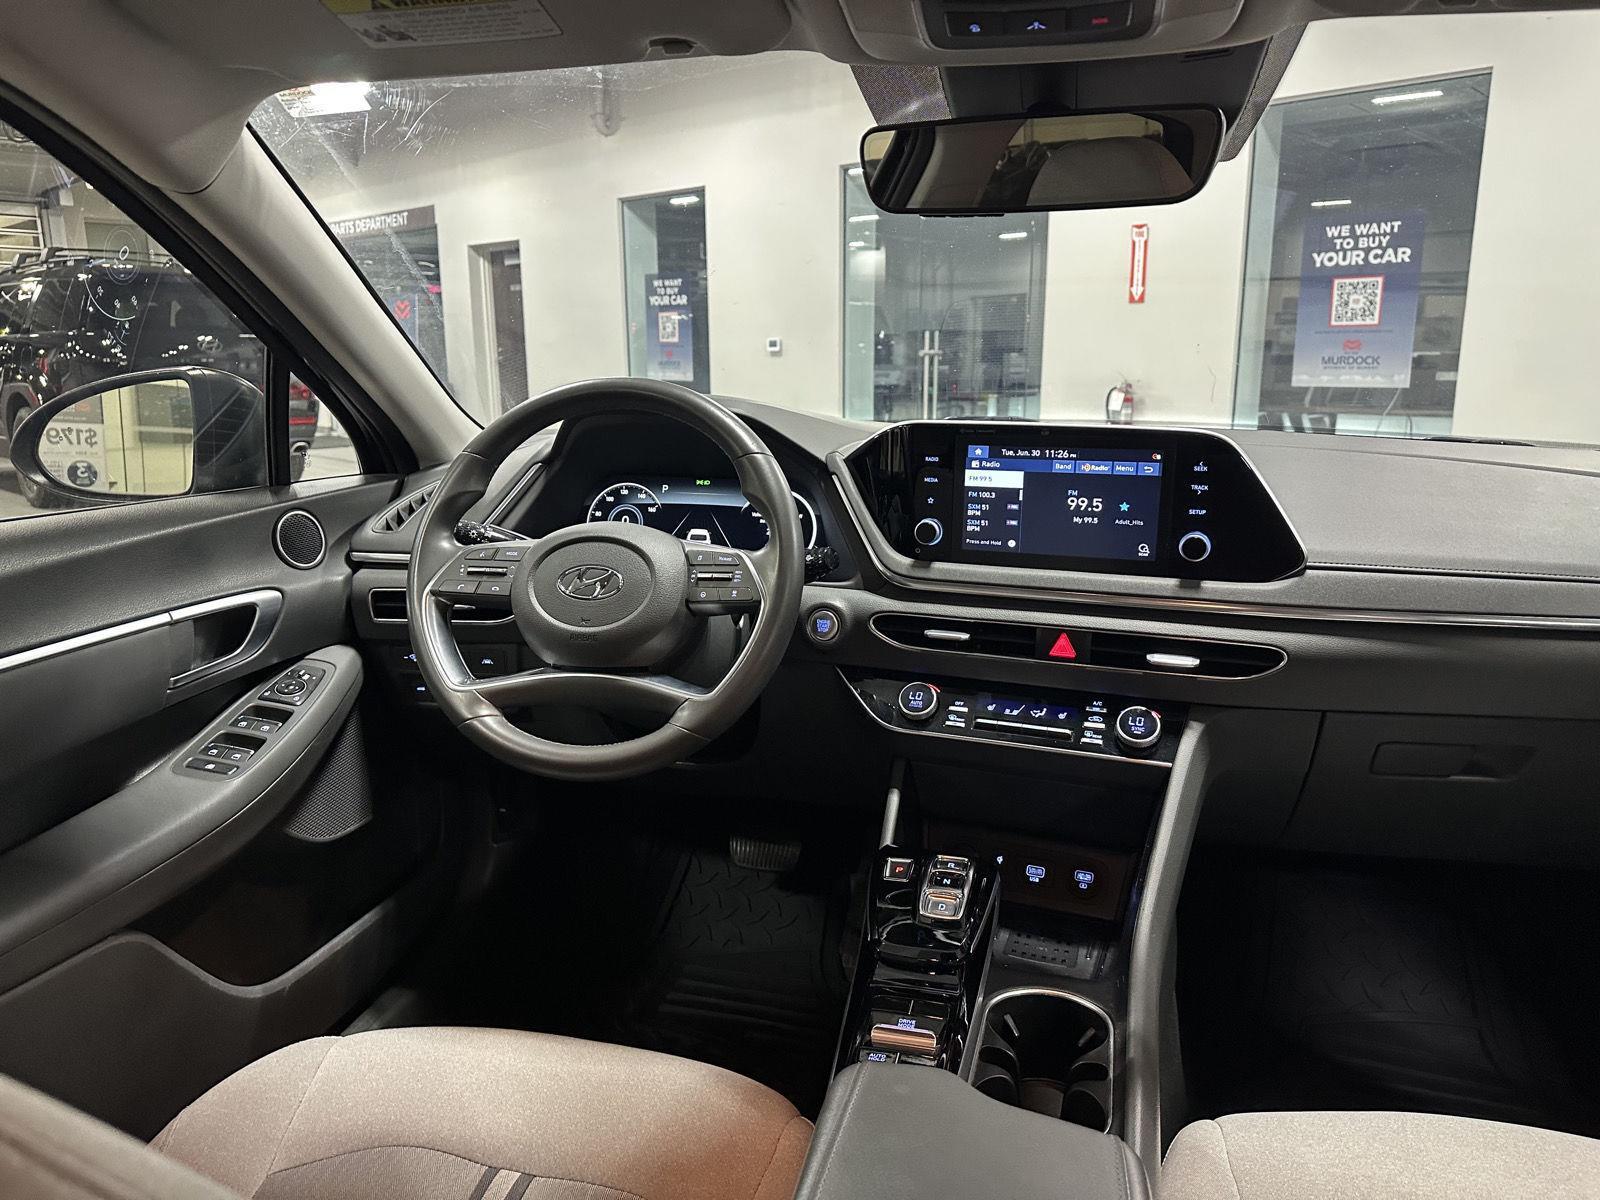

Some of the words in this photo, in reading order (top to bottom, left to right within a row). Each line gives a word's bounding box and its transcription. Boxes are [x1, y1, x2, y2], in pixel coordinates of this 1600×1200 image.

[330, 221, 355, 234] PARTS
[355, 212, 408, 232] DEPARTMENT
[1326, 225, 1350, 238] WE
[1354, 221, 1401, 236] WANT
[1334, 239, 1354, 250] TO
[1358, 235, 1390, 248] BUY
[1312, 250, 1364, 267] YOUR
[1368, 247, 1411, 264] CAR
[652, 279, 663, 288] WE
[664, 278, 682, 287] WANT
[656, 287, 665, 295] TO
[666, 287, 679, 295] BUY
[649, 296, 670, 306] YOUR
[671, 294, 688, 305] CAR
[1321, 355, 1380, 365] MURDOCK
[1001, 448, 1015, 456] Tue,
[1045, 449, 1069, 458] 11:26
[981, 460, 1000, 468] Radio
[662, 484, 669, 494] P
[1067, 497, 1103, 512] 99.5
[895, 865, 904, 873] P
